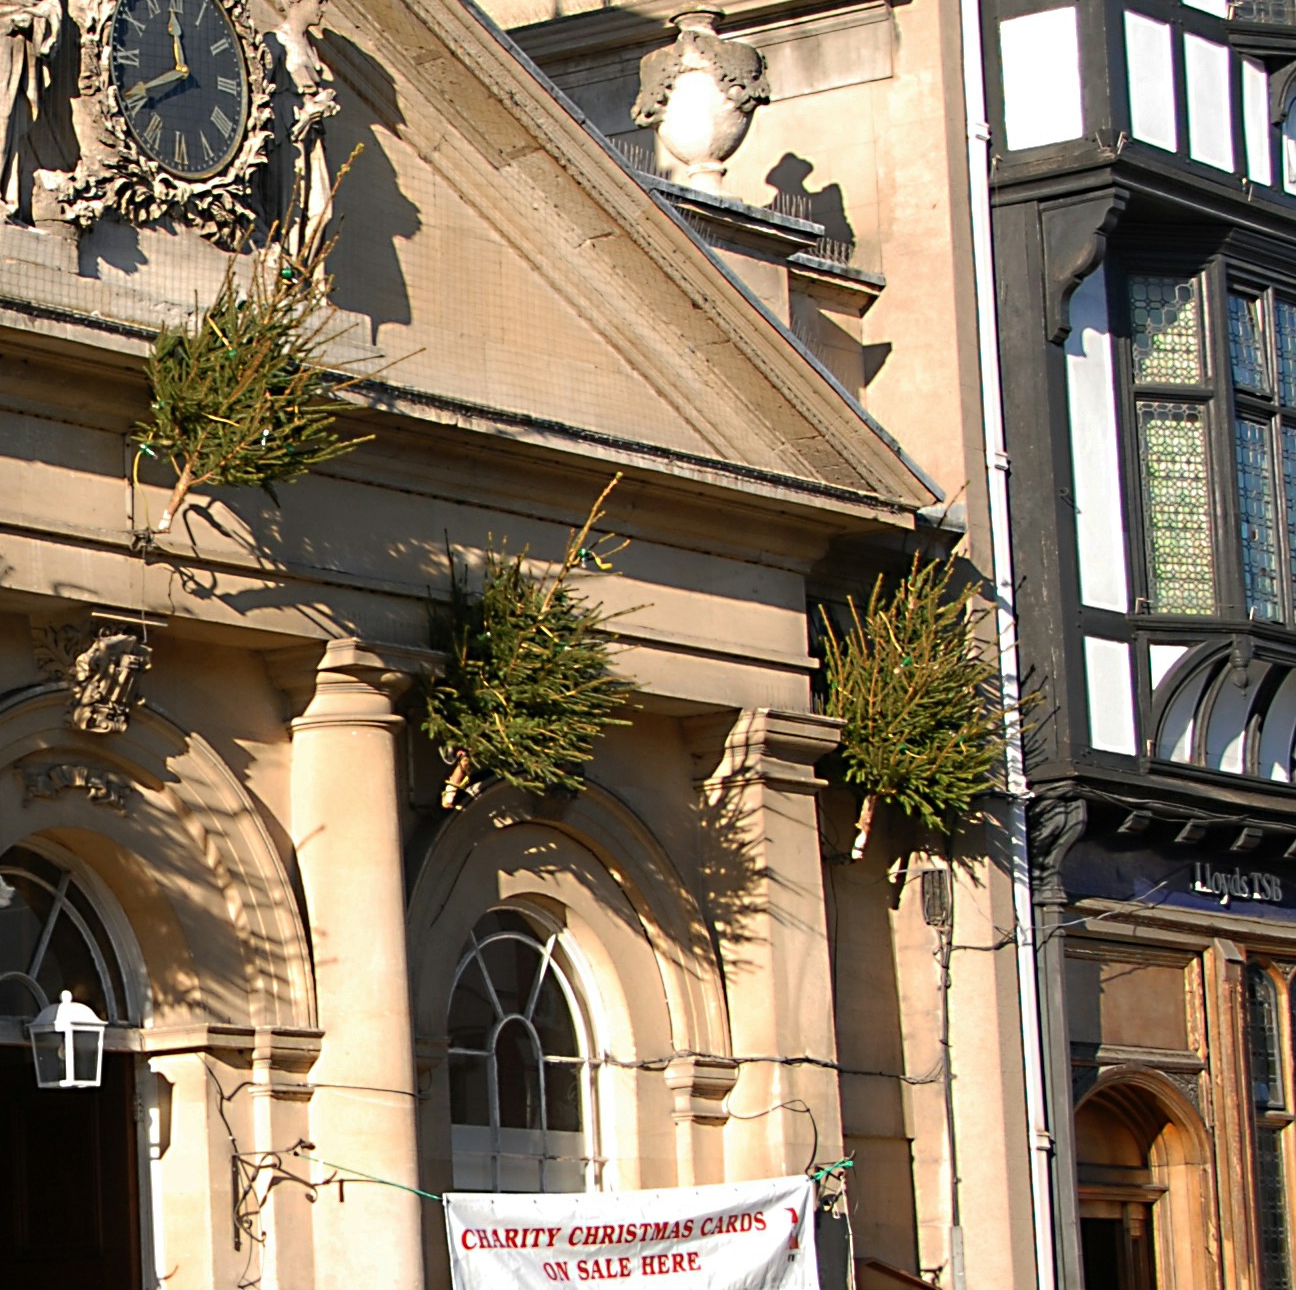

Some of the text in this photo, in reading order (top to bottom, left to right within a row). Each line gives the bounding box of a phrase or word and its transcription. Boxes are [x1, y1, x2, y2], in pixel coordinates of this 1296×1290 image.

[1195, 862, 1283, 905] Lloyds TSB
[461, 1211, 767, 1251] CHARITY CHRISTMAS CARDS
[543, 1252, 702, 1282] ON SALE HERE
